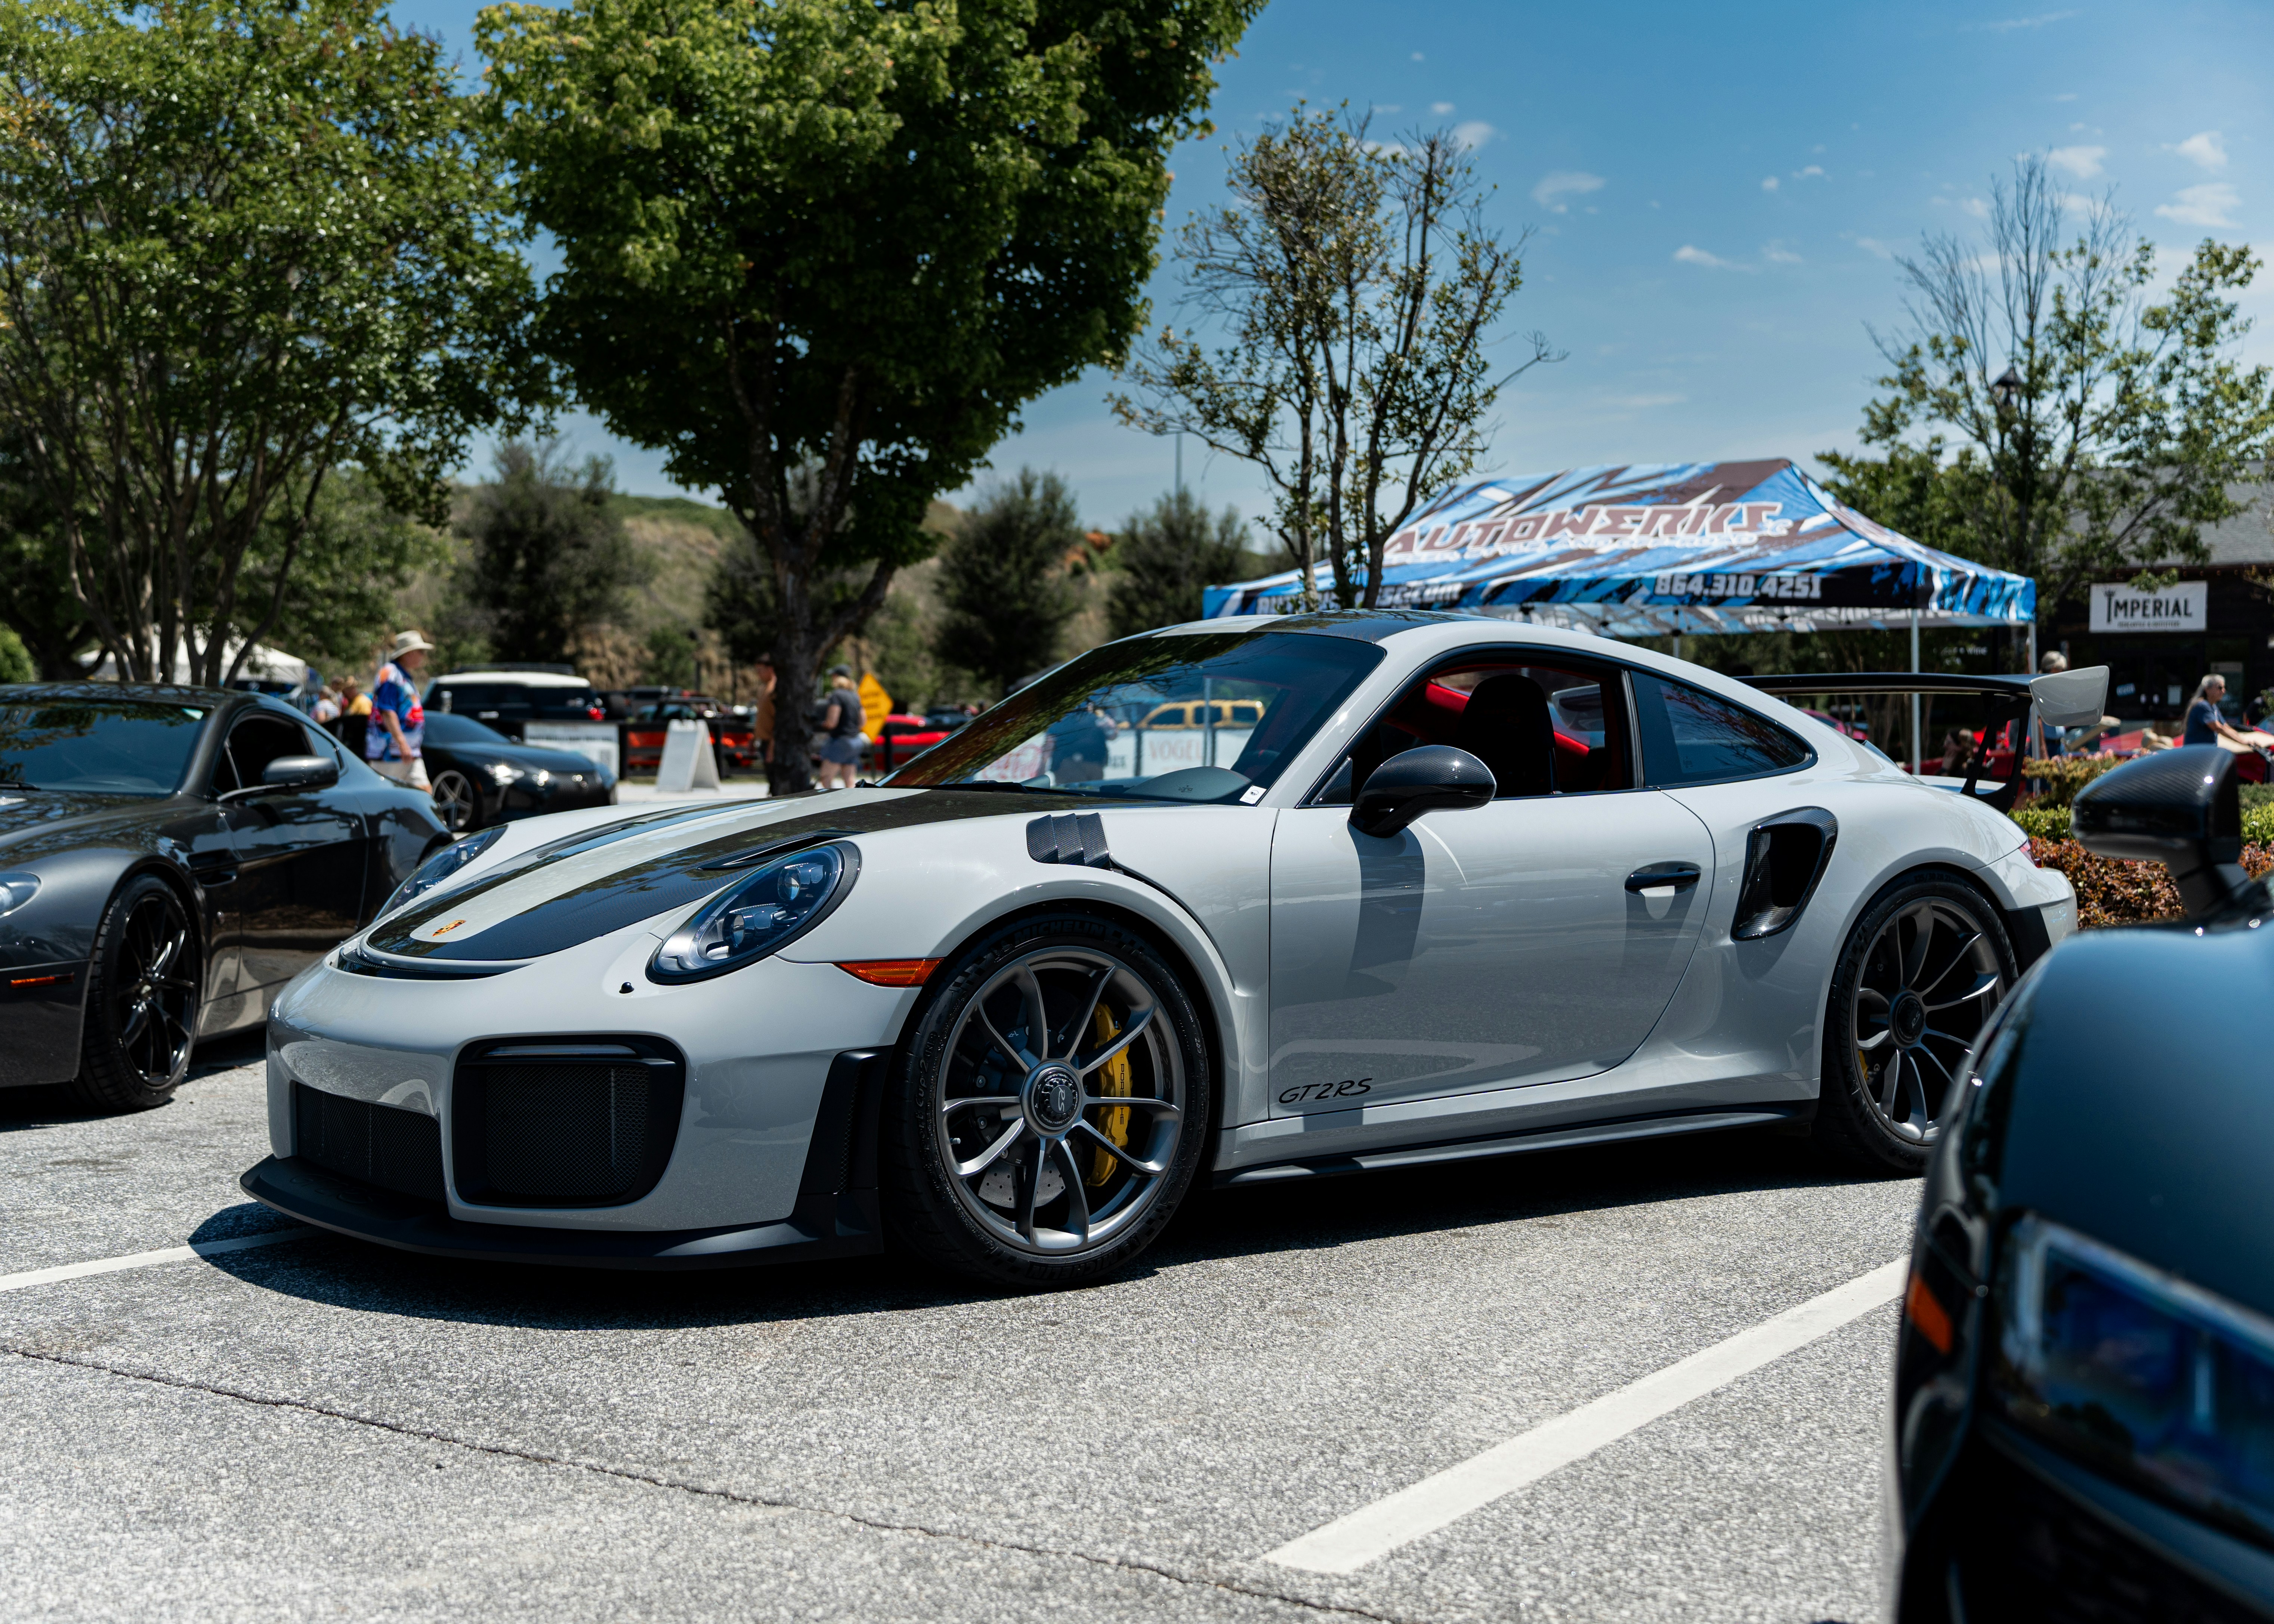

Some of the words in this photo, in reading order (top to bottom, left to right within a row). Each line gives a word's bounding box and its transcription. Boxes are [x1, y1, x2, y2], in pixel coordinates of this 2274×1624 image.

[1654, 574, 1821, 598] 864.310.4251
[2105, 592, 2193, 624] IMPERIAL
[1014, 921, 1105, 945] MICHELIN
[1839, 959, 1858, 1067] MICHELIN
[1911, 1011, 1921, 1028] RS
[920, 1058, 929, 1073] 2
[915, 1075, 927, 1107] Cup
[1058, 1086, 1065, 1112] RS
[1028, 1250, 1119, 1280] MICHELIN
